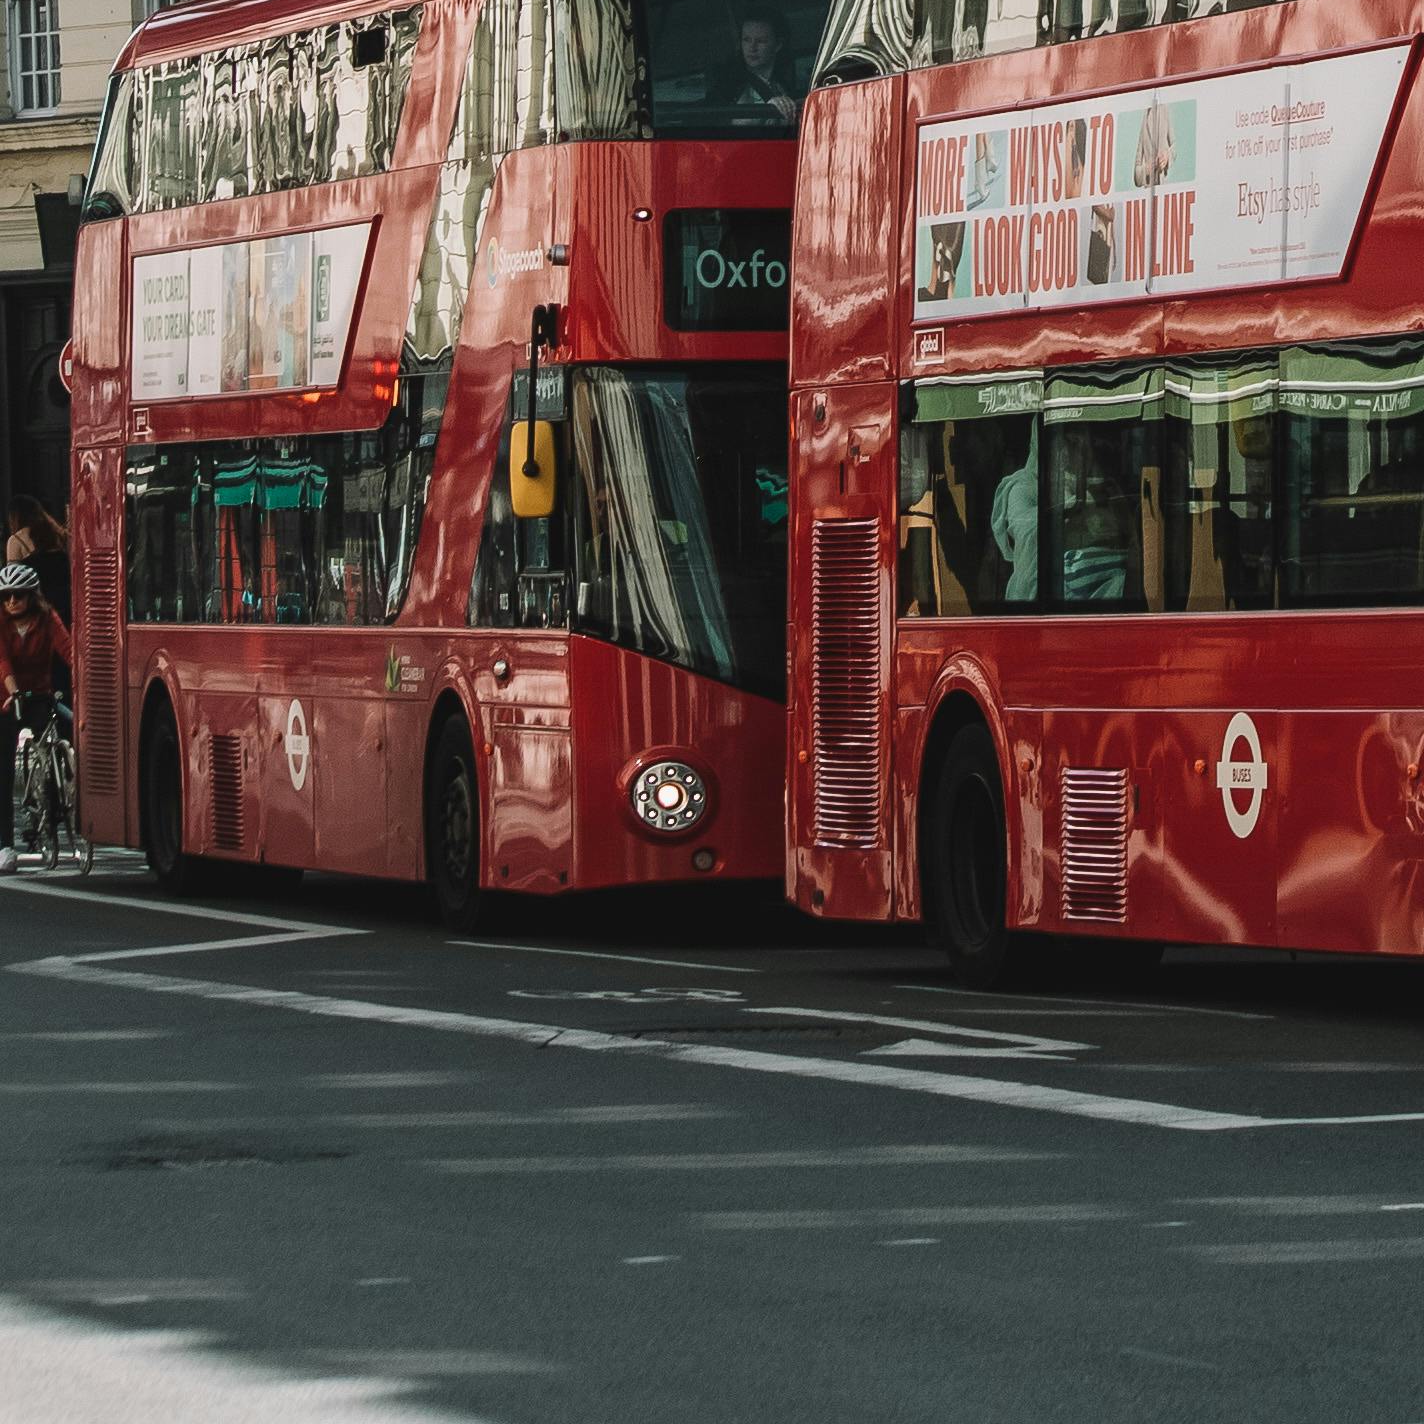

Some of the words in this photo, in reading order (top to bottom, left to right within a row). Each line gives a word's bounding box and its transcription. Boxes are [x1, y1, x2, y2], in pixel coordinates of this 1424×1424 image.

[1235, 109, 1249, 128] Use
[1251, 105, 1269, 126] code
[919, 135, 968, 217] MORE
[1010, 121, 1063, 206] WAYS
[1090, 113, 1114, 196] TO
[1265, 138, 1281, 158] your
[1237, 183, 1268, 224] Etsy
[1269, 177, 1290, 213] has
[1293, 172, 1320, 218] style
[974, 214, 1024, 297] LOOK
[1028, 208, 1079, 293] GOOD
[1125, 199, 1146, 281] IN
[1152, 191, 1195, 277] LINE
[697, 249, 786, 288] Oxfo
[143, 278, 163, 306] YOUR
[143, 315, 163, 342] YOUR
[197, 308, 215, 336] GATE
[1232, 768, 1251, 782] BUSES
